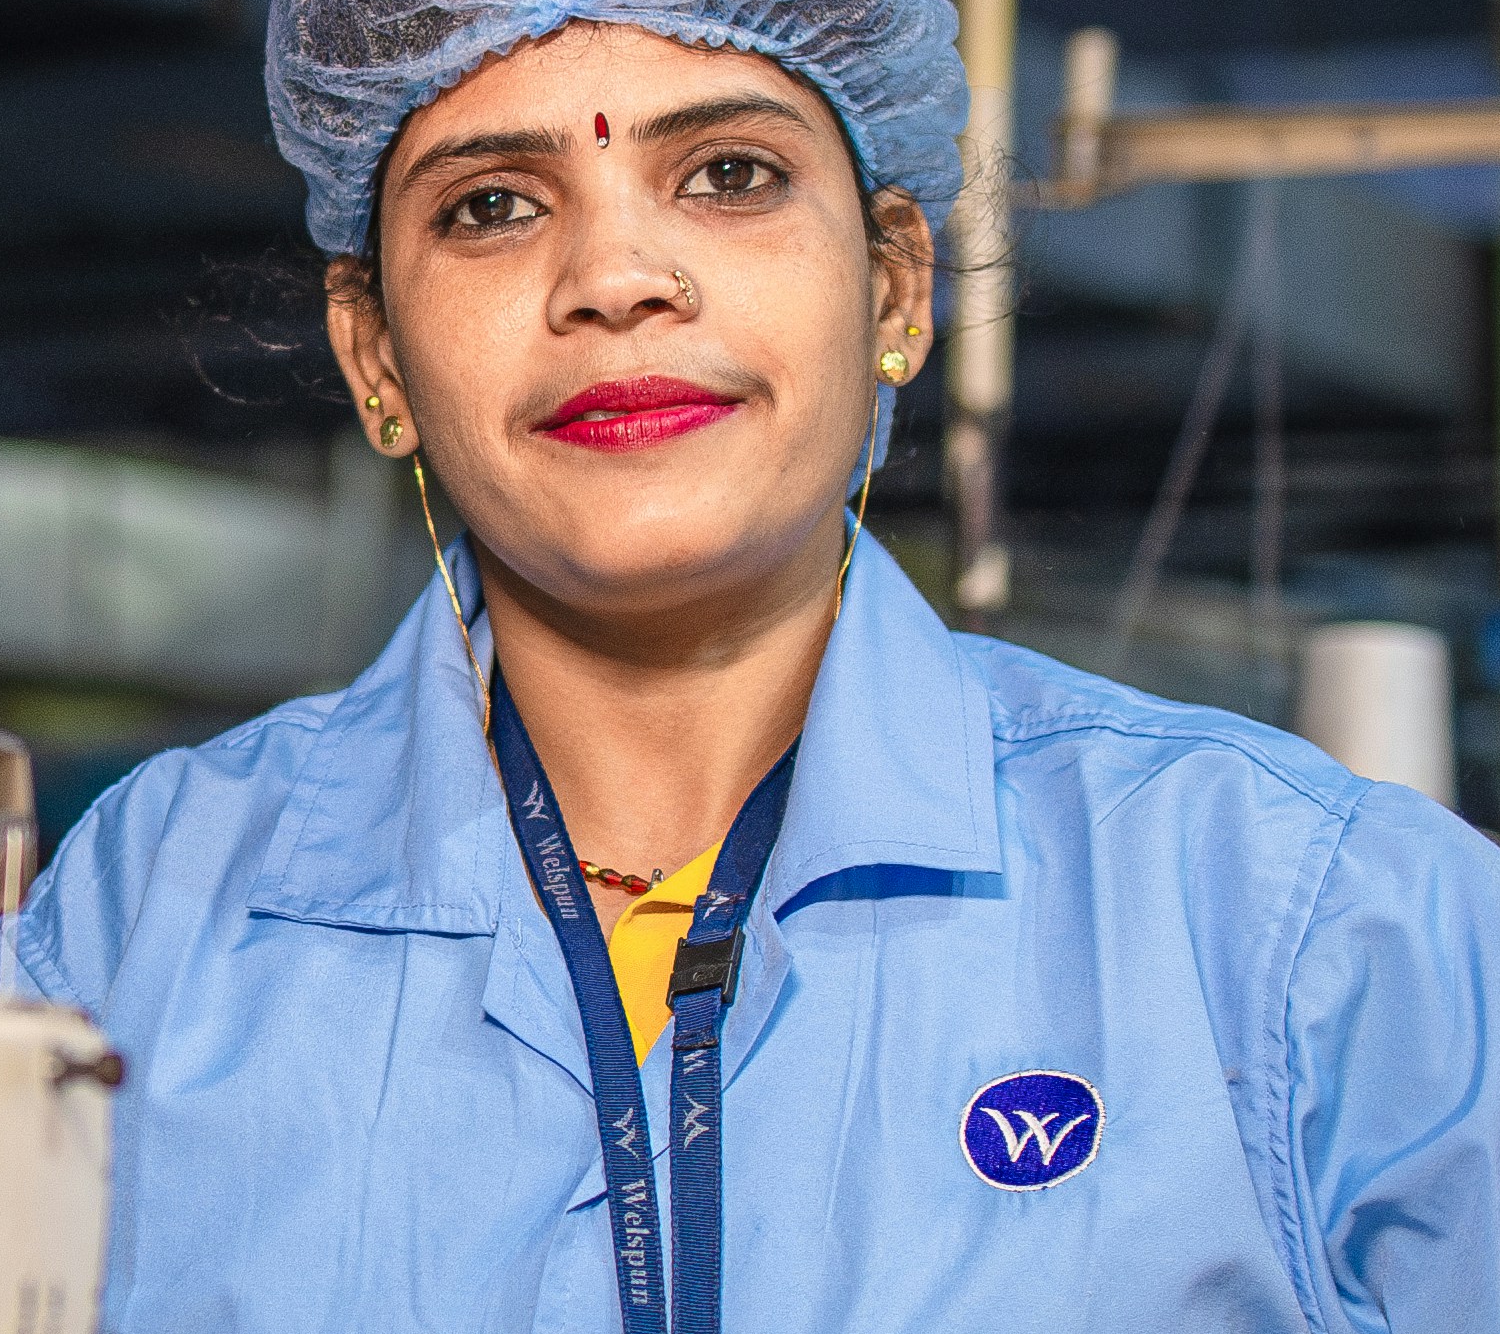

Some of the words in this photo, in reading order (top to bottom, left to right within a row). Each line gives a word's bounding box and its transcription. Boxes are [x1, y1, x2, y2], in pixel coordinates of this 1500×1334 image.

[536, 831, 580, 920] Welspun
[979, 1107, 1091, 1166] W
[619, 1177, 650, 1306] Welspun
